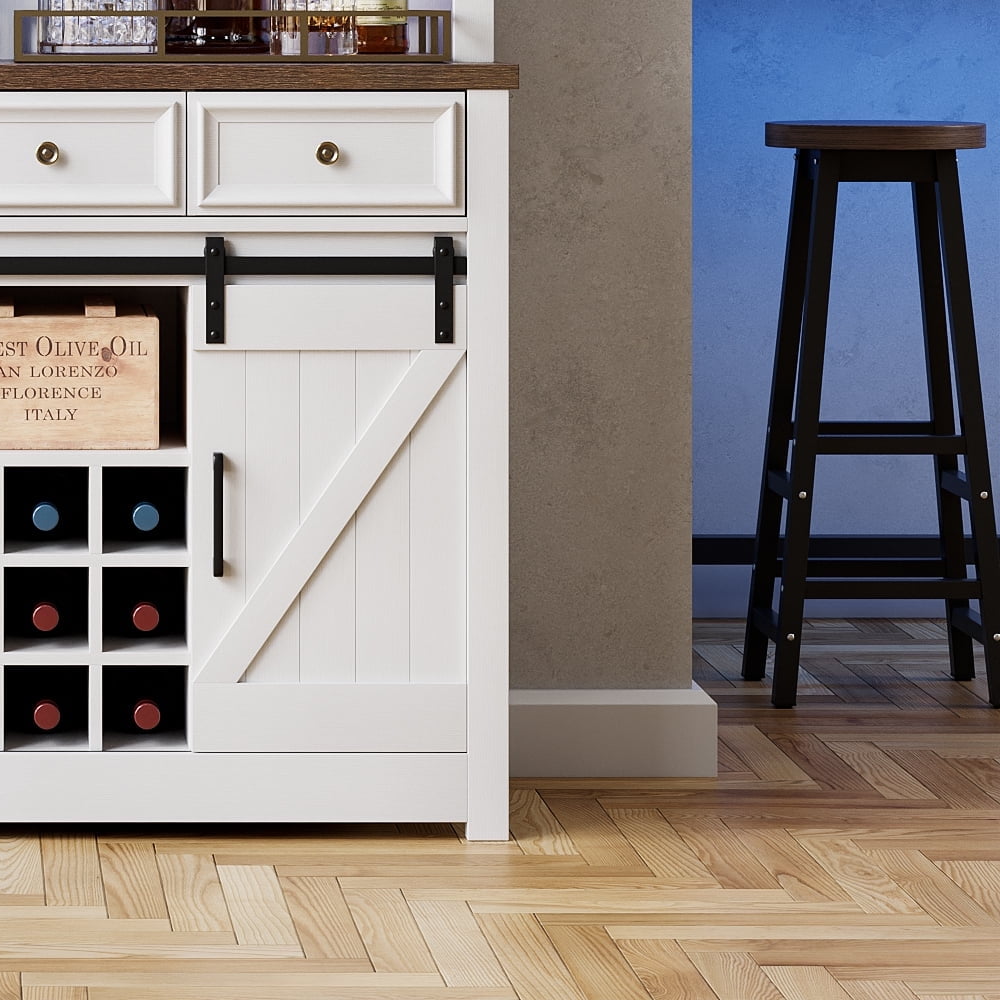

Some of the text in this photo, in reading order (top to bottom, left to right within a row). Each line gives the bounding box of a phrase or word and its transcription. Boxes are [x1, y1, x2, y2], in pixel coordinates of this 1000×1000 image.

[36, 335, 99, 357] OLIVE
[110, 335, 148, 357] OIL
[30, 366, 117, 378] LORENZO
[1, 387, 102, 400] FLORENCE
[24, 408, 79, 421] ITALY
